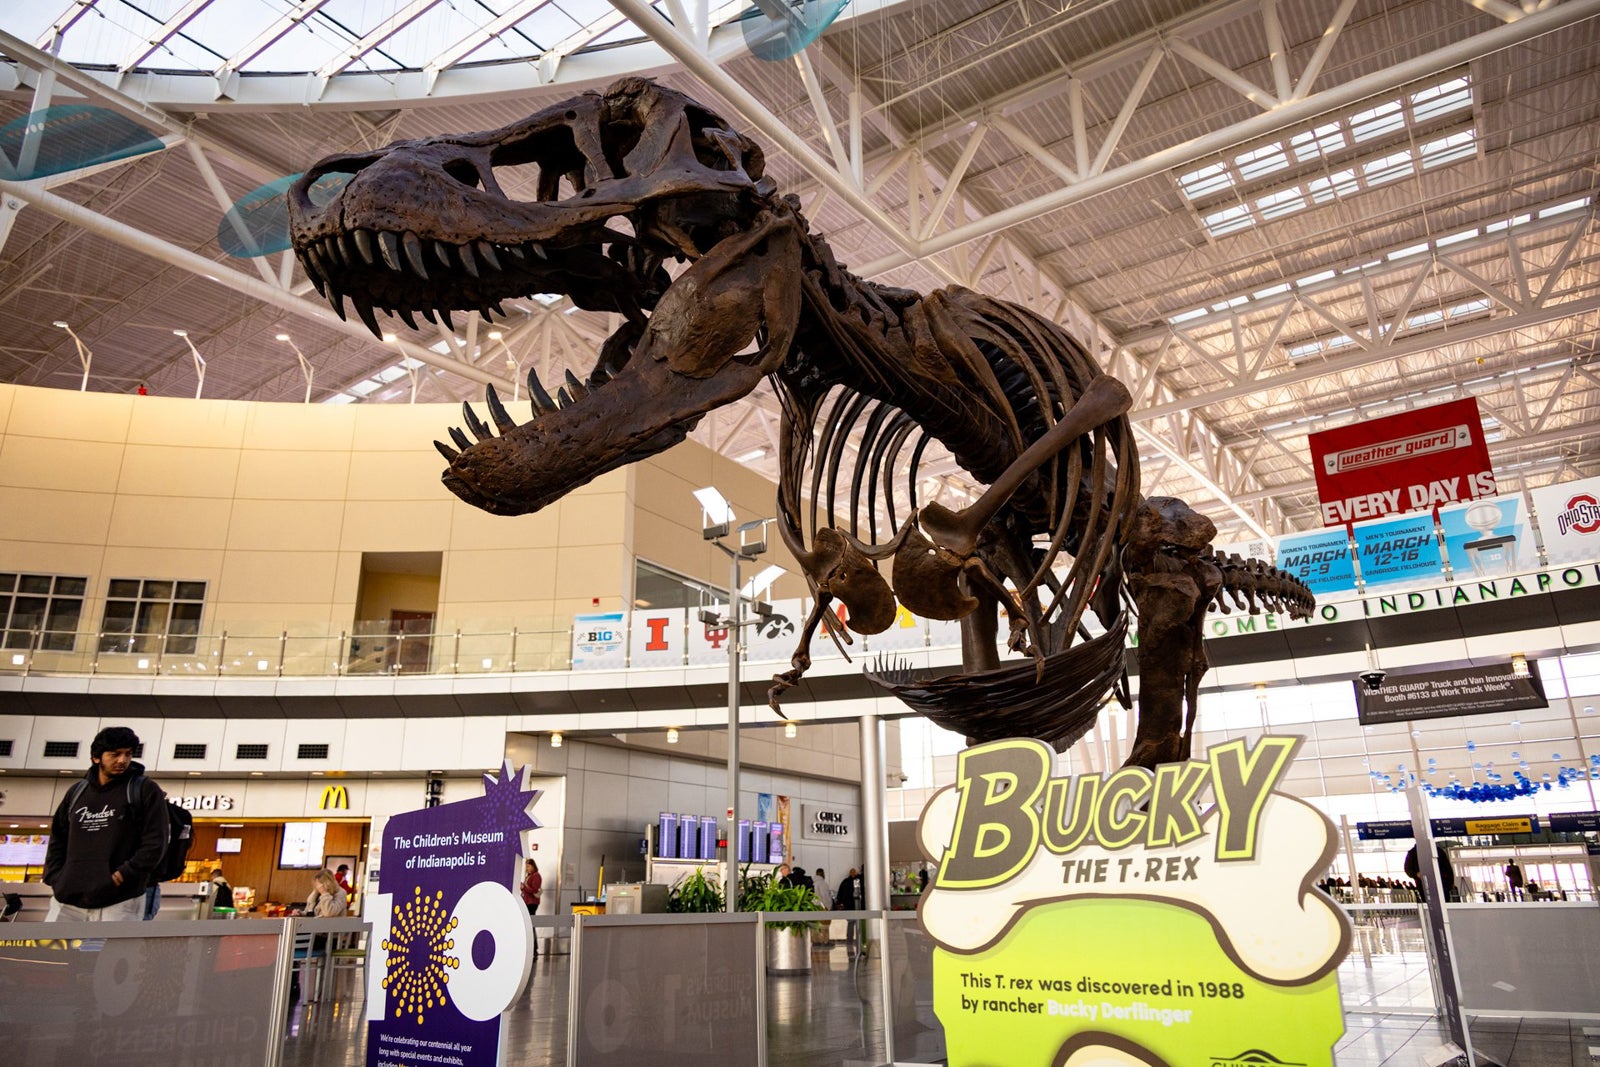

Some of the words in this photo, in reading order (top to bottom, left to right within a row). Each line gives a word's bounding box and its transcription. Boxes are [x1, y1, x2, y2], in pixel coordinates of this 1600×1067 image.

[1342, 444, 1401, 466] weather
[1405, 433, 1449, 454] guard
[1321, 488, 1401, 524] EVERY
[1408, 476, 1460, 508] DAY
[1467, 470, 1496, 496] IS
[1365, 533, 1385, 541] MEN'S
[1385, 526, 1426, 537] TOURNAMENT
[1281, 544, 1307, 554] WOMEN'S
[1308, 539, 1346, 551] TOURNAMENT
[1363, 534, 1430, 556] MARCH
[1284, 549, 1347, 568] MARCH
[1374, 549, 1420, 566] 12-16
[1401, 560, 1437, 572] FIELDHOUSE
[1299, 563, 1330, 577] 5-9
[1430, 680, 1452, 689] Truck
[1453, 678, 1468, 686] and
[1384, 694, 1406, 702] Booth
[1407, 691, 1430, 700] #6133
[1431, 690, 1439, 698] at
[1440, 688, 1460, 697] Work
[1461, 686, 1483, 694] Truck
[165, 795, 233, 810] nald's
[75, 805, 115, 822] Fender
[935, 735, 1303, 890] BUCKY
[394, 836, 411, 849] The
[413, 833, 459, 848] Children's
[462, 831, 504, 845] Museum
[405, 856, 416, 869] of
[417, 853, 475, 869] Indianapolis
[477, 852, 486, 865] is
[1062, 858, 1109, 883] THE
[961, 973, 991, 988] This
[995, 975, 1006, 989] T.
[1009, 978, 1033, 990] rex
[1038, 980, 1072, 992] was
[1077, 977, 1172, 996] discovered
[1177, 980, 1193, 997] in
[1199, 981, 1245, 999] 1988
[961, 995, 979, 1013] by
[983, 997, 1044, 1014] rancher
[1047, 998, 1098, 1021] Bucky
[1101, 1000, 1192, 1027] Derflinger
[380, 1034, 393, 1042] We're
[394, 1036, 419, 1047] celebrating
[428, 1041, 453, 1050] centennial
[379, 1047, 389, 1057] long
[390, 1049, 399, 1057] with
[401, 1051, 416, 1059] special
[417, 1053, 432, 1061] events
[433, 1055, 442, 1063] and
